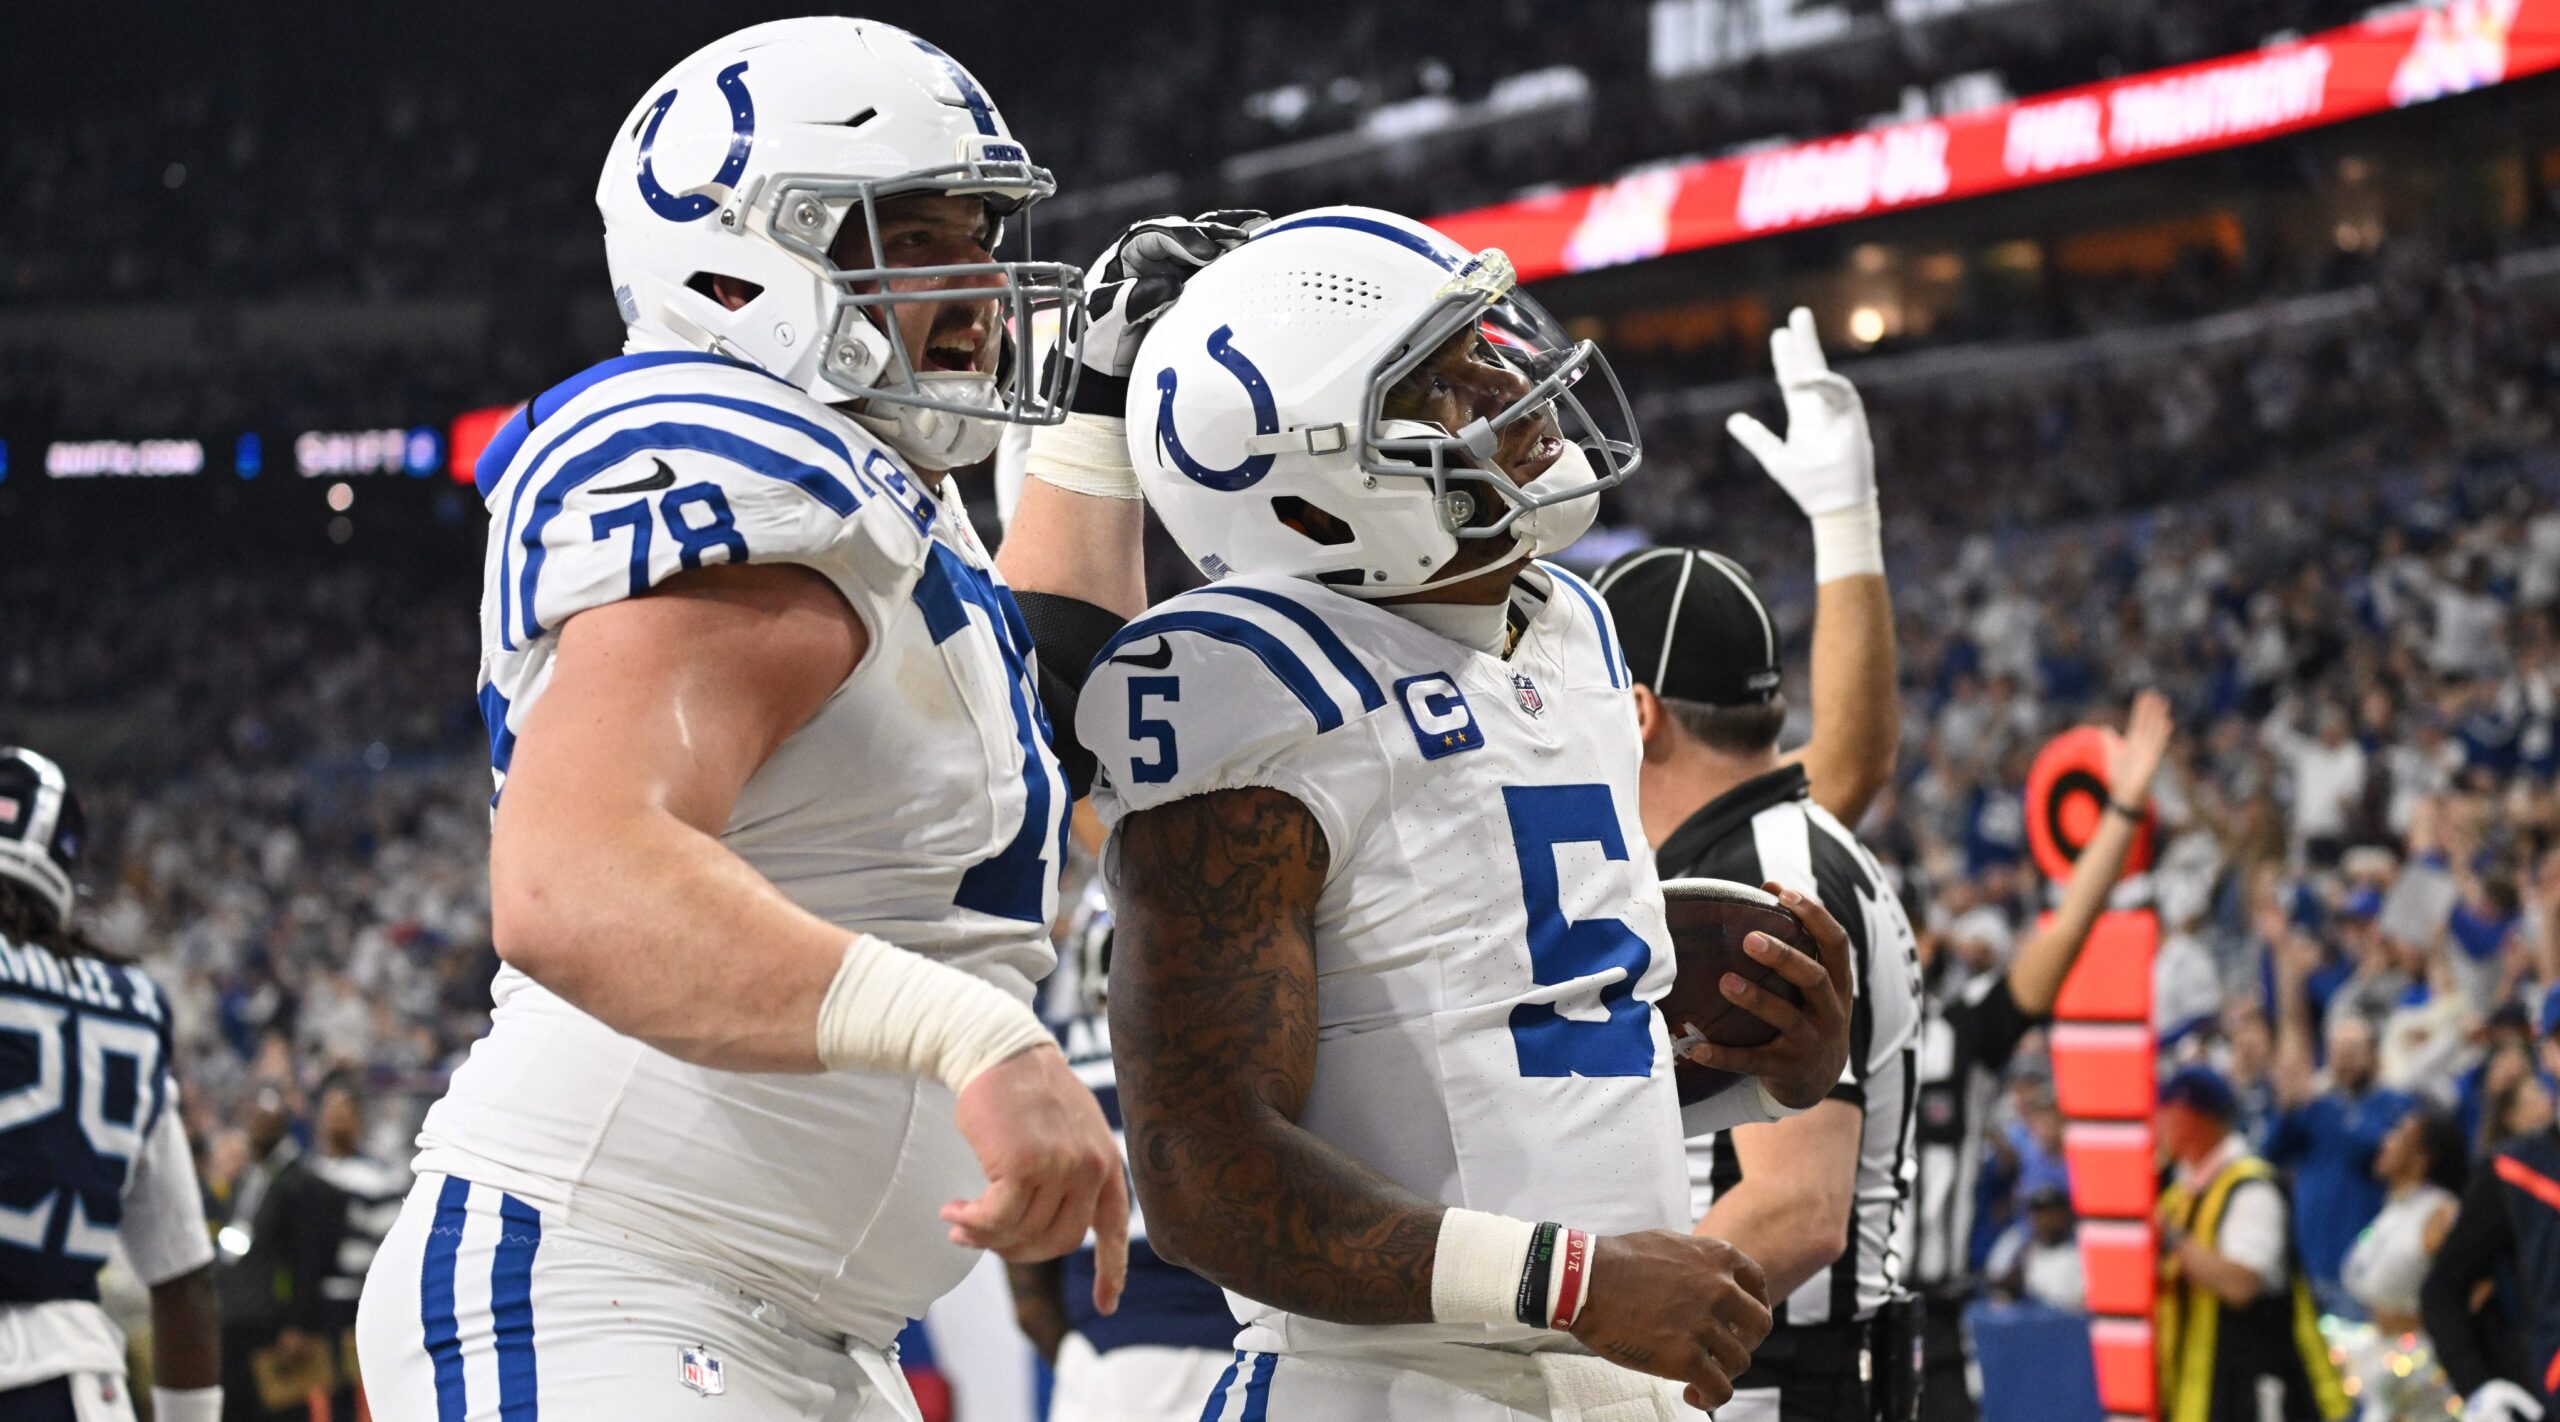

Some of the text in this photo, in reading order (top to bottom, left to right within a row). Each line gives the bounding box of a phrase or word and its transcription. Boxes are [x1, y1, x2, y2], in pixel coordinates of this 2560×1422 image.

[591, 481, 749, 598] 78
[1126, 675, 1180, 784] 5
[1406, 680, 1470, 735] C
[1502, 783, 1656, 1078] 5
